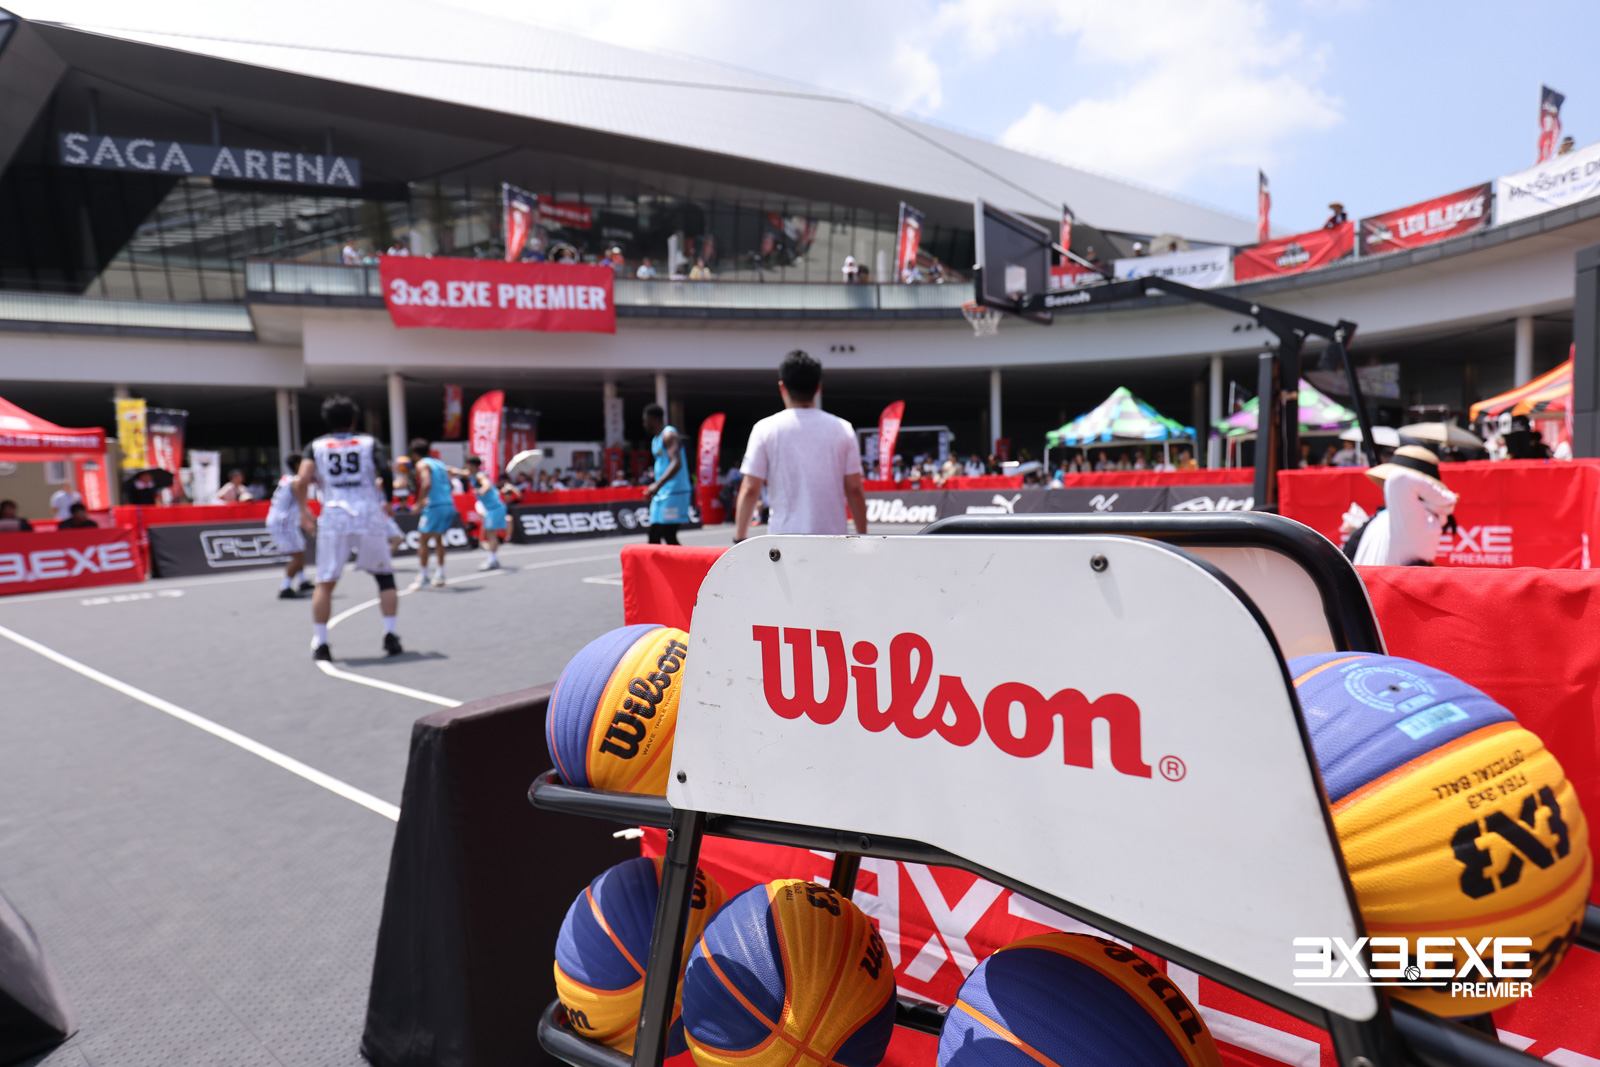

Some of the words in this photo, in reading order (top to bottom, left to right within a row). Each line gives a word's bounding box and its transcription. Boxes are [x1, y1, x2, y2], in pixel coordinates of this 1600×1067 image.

[63, 132, 193, 173] SAGA
[211, 146, 356, 187] ARENA
[390, 278, 492, 308] 3x3.EXE
[497, 283, 606, 310] PREMIER
[329, 452, 359, 475] 39
[865, 498, 937, 523] Wilson
[598, 639, 687, 759] Wilson
[752, 624, 1152, 778] Wilson
[642, 733, 656, 756] WAVE
[1432, 775, 1471, 799] BALL
